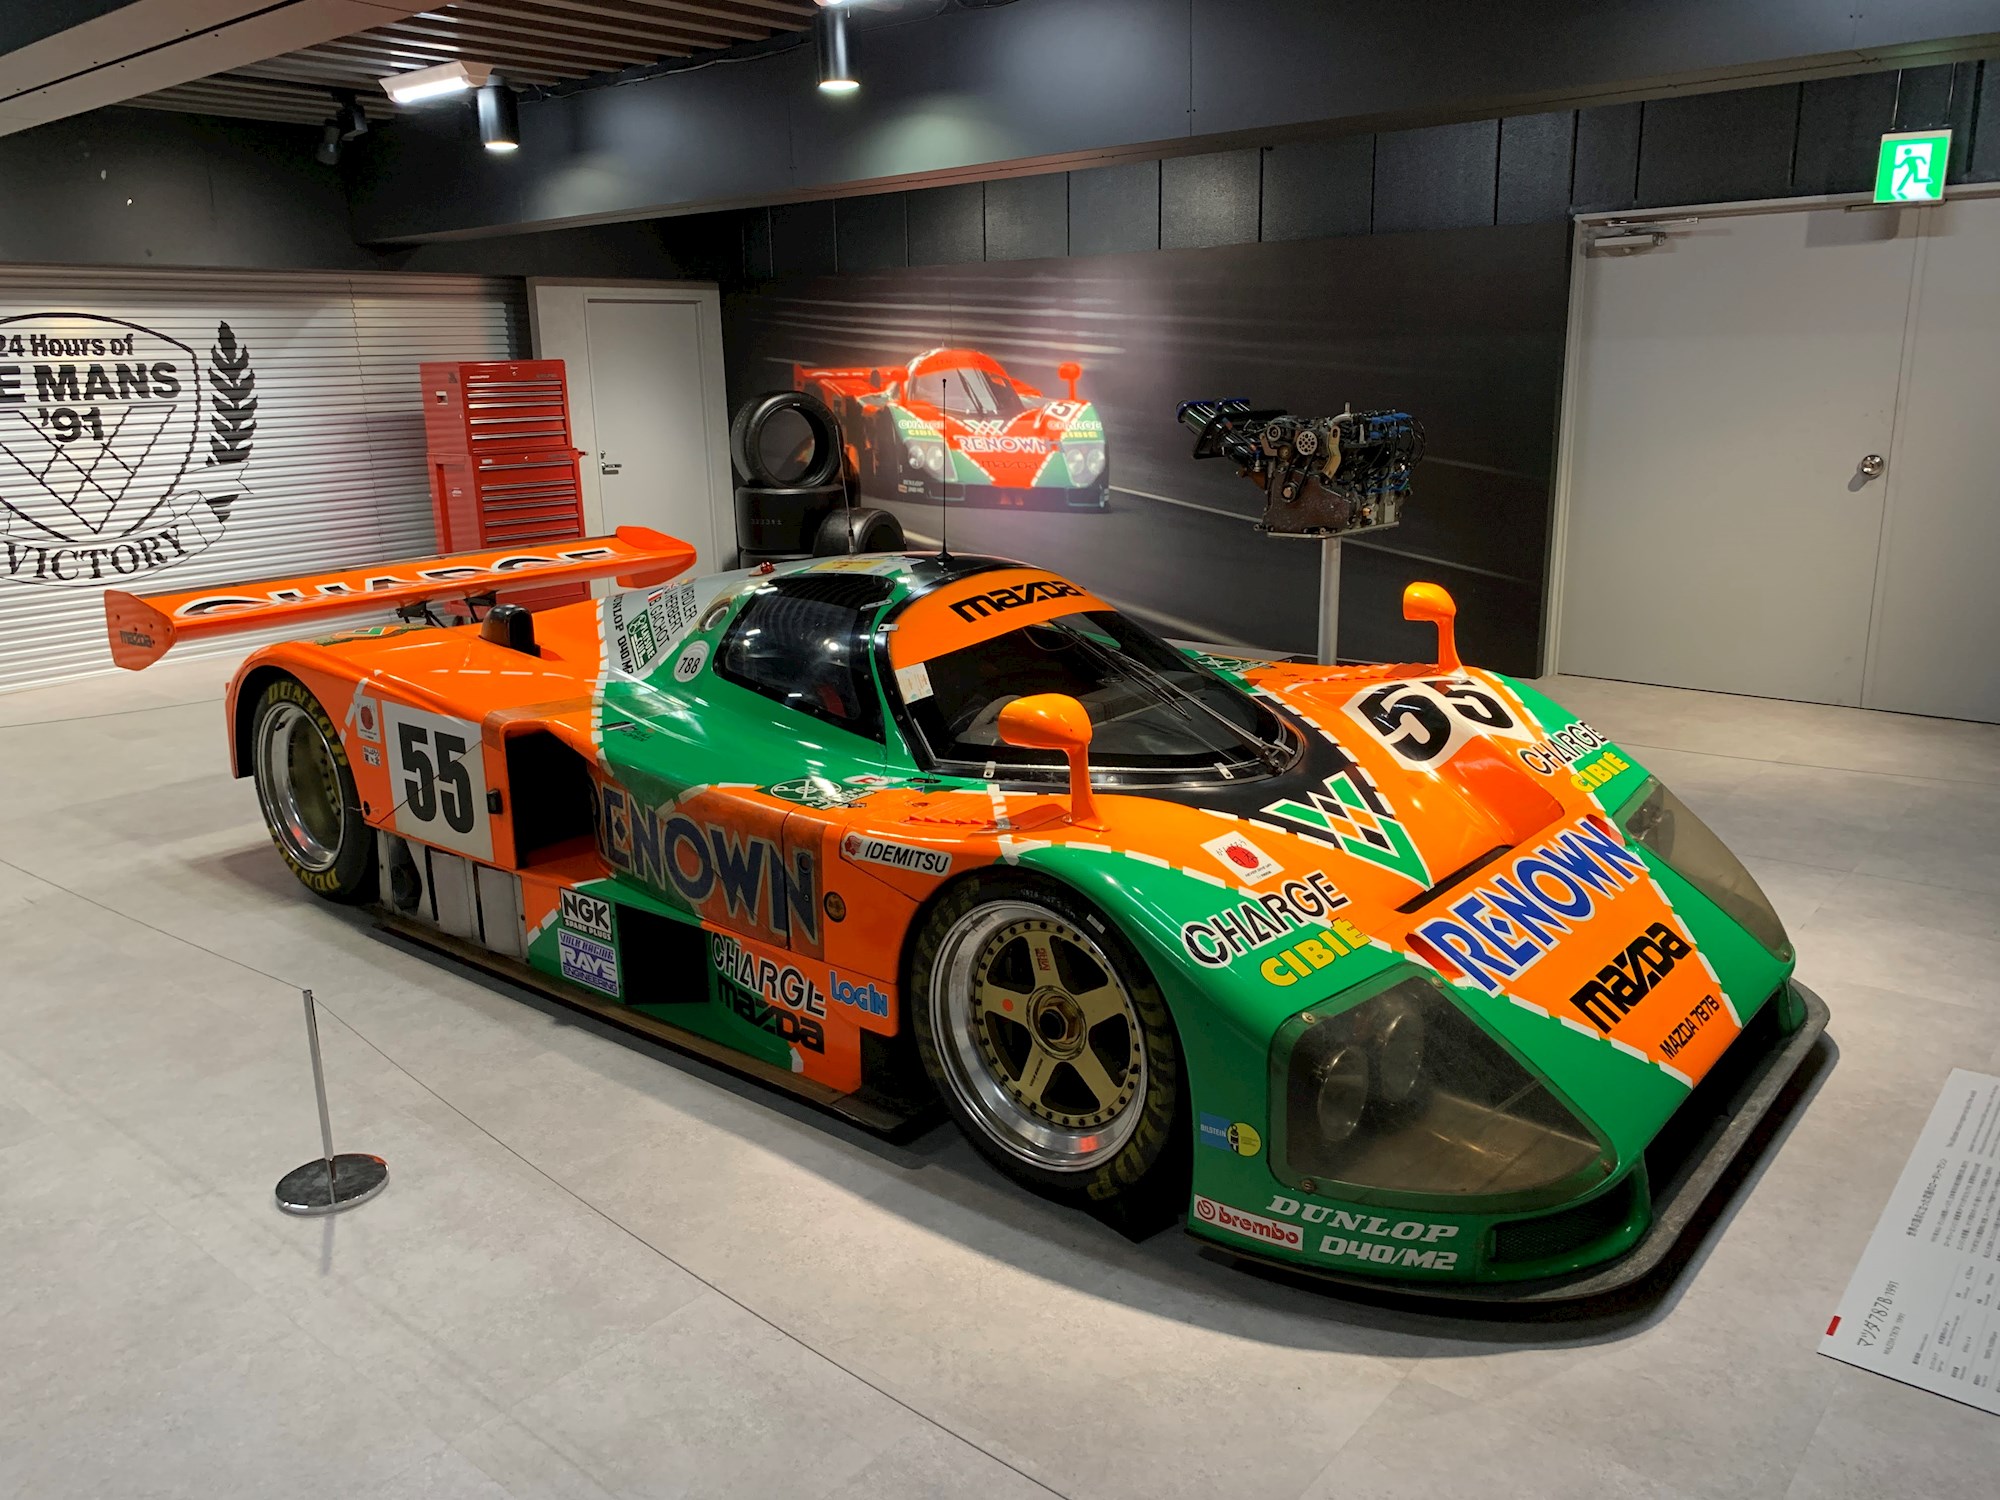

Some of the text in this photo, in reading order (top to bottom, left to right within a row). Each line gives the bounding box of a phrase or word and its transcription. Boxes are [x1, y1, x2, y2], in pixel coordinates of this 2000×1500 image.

[30, 334, 106, 357] Hours
[110, 333, 134, 356] of
[0, 362, 182, 403] E MANS
[953, 435, 1047, 454] RENOWN
[4, 525, 189, 580] VICTORY
[649, 596, 670, 647] B.GACHOT
[948, 581, 1086, 623] mazda
[120, 631, 153, 648] mazda
[678, 657, 701, 674] 788
[1358, 681, 1513, 762] 55
[1517, 720, 1610, 776] CHARGE
[398, 722, 475, 834] 55
[1569, 751, 1631, 793] CIBIE
[864, 841, 949, 874] IDEMITSU
[563, 892, 609, 931] NGK
[1181, 869, 1352, 969] CHARGE
[1414, 817, 1650, 998] RENOWN
[565, 918, 612, 940] SPARK PLUGS
[582, 940, 614, 960] RACING
[560, 945, 616, 982] RAYS
[1260, 917, 1372, 987] CIBIE
[563, 965, 618, 992] ENGINEERING
[711, 931, 827, 1020] CHARGE
[1569, 922, 1692, 1034] mazda
[717, 972, 825, 1055] mazda
[1658, 995, 1721, 1060] MAZDA 787B
[1200, 1123, 1227, 1138] BILSTEIN
[1218, 1206, 1299, 1245] brembo
[1266, 1195, 1460, 1243] DUNLOP
[1319, 1235, 1458, 1271] D40/M2
